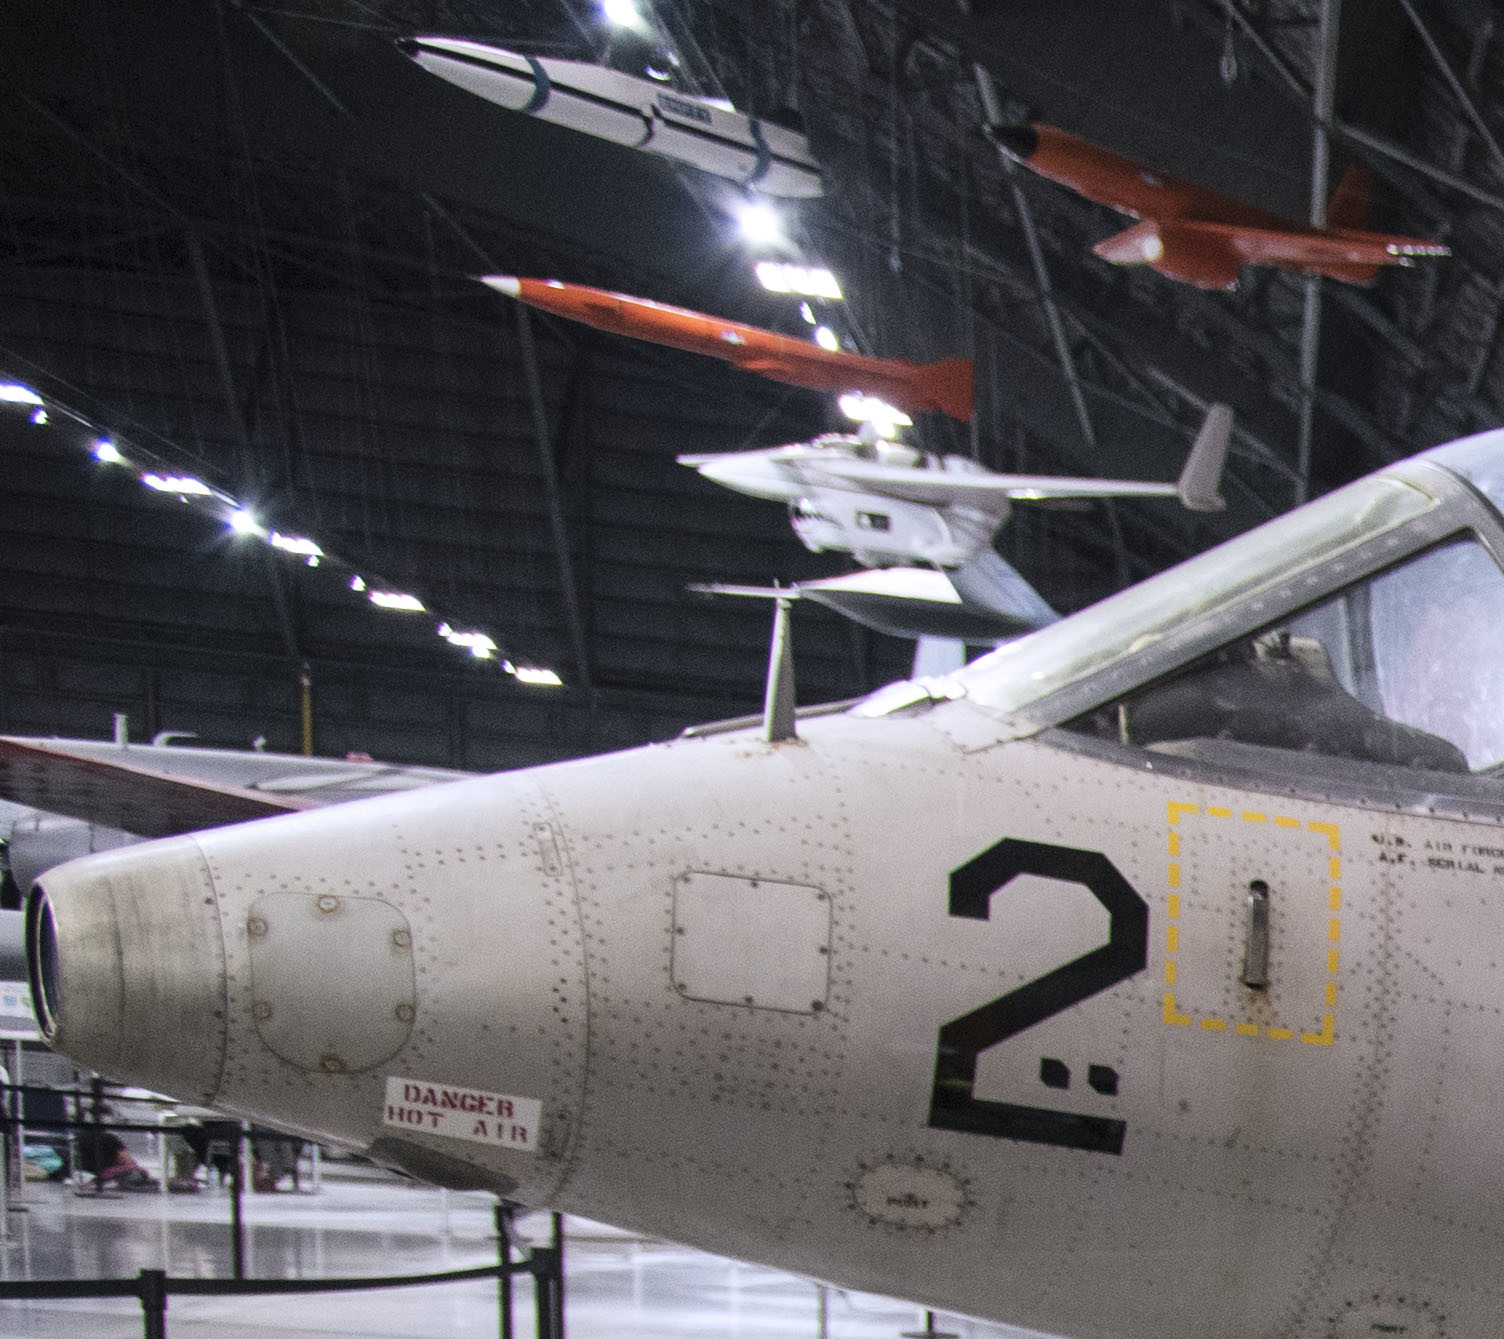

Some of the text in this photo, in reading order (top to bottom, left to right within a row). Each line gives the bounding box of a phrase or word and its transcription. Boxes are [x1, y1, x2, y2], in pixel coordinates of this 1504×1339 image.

[927, 838, 1149, 1155] 2
[404, 1084, 514, 1118] DANGER
[388, 1106, 528, 1142] HOT AIR
